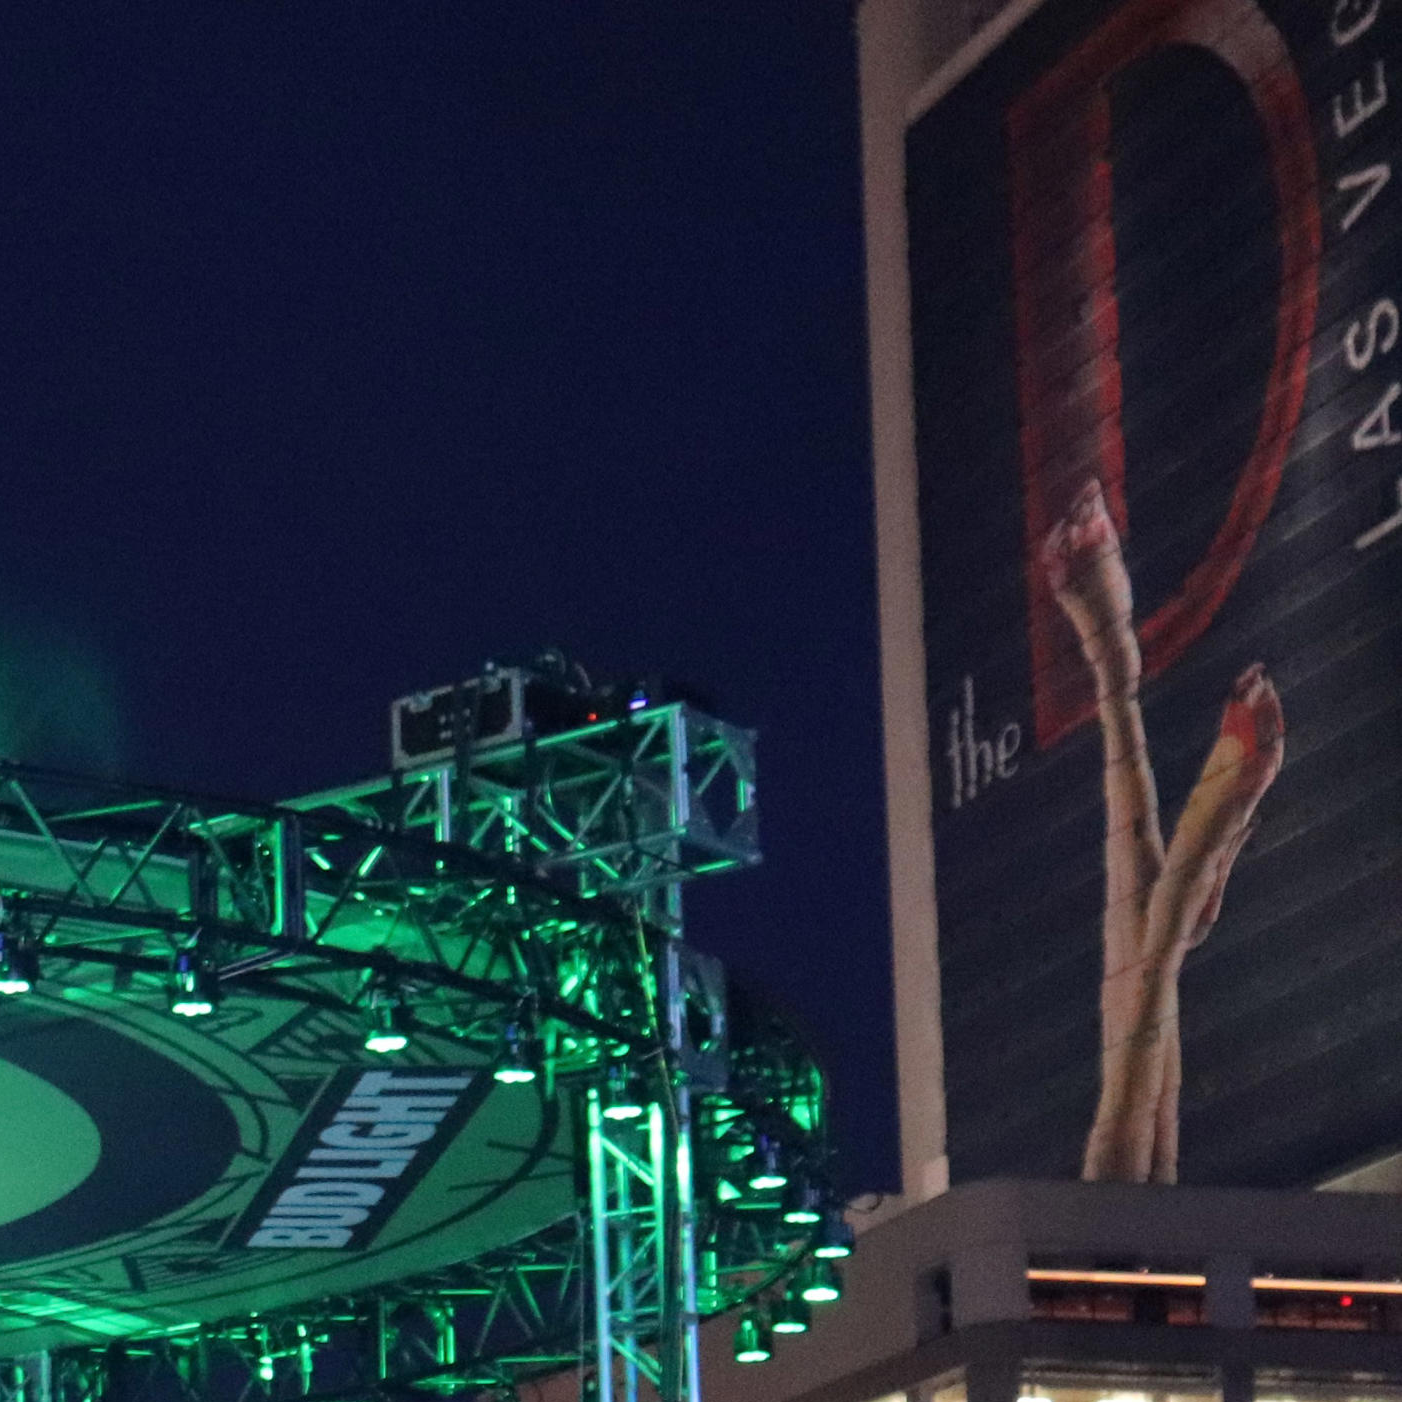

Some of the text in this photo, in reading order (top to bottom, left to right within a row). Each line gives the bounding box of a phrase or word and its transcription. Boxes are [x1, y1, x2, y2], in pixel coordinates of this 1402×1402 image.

[947, 675, 1022, 807] the
[245, 1070, 479, 1249] BUD LIGHT
